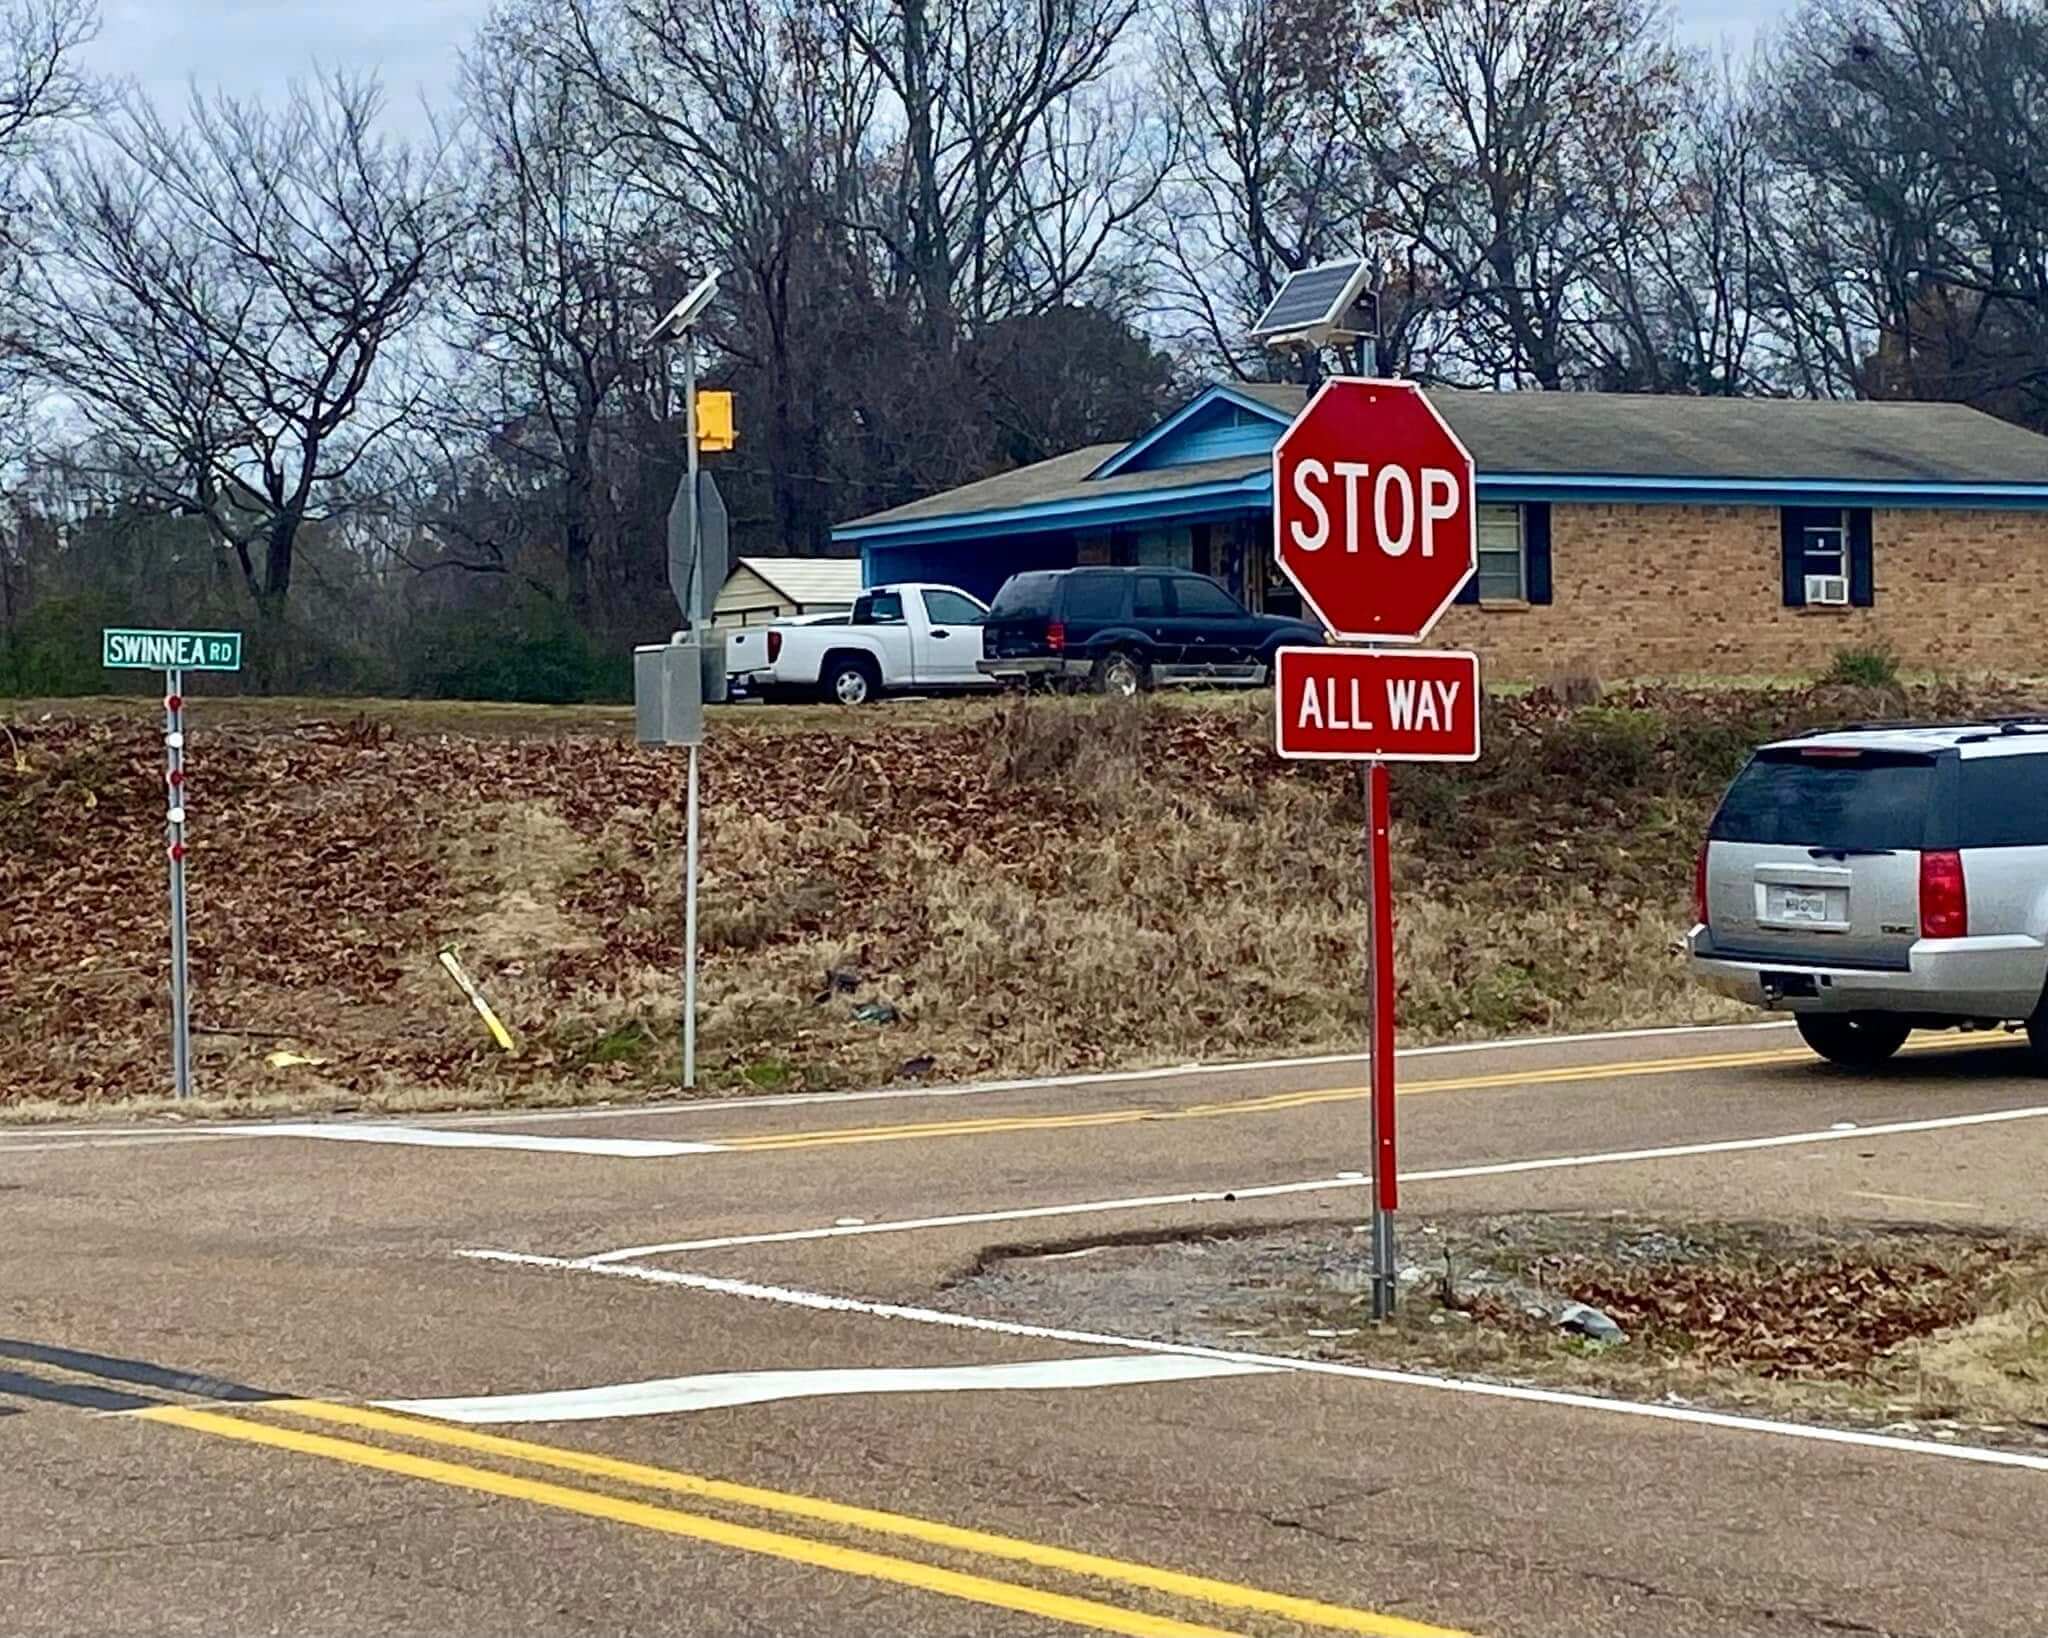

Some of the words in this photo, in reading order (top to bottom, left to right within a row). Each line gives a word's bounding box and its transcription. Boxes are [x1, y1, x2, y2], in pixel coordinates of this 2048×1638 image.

[1290, 457, 1460, 557] STOP
[109, 635, 205, 664] SWINNEA
[209, 642, 232, 661] RD
[1298, 676, 1373, 730] ALL
[1386, 678, 1460, 732] WAY
